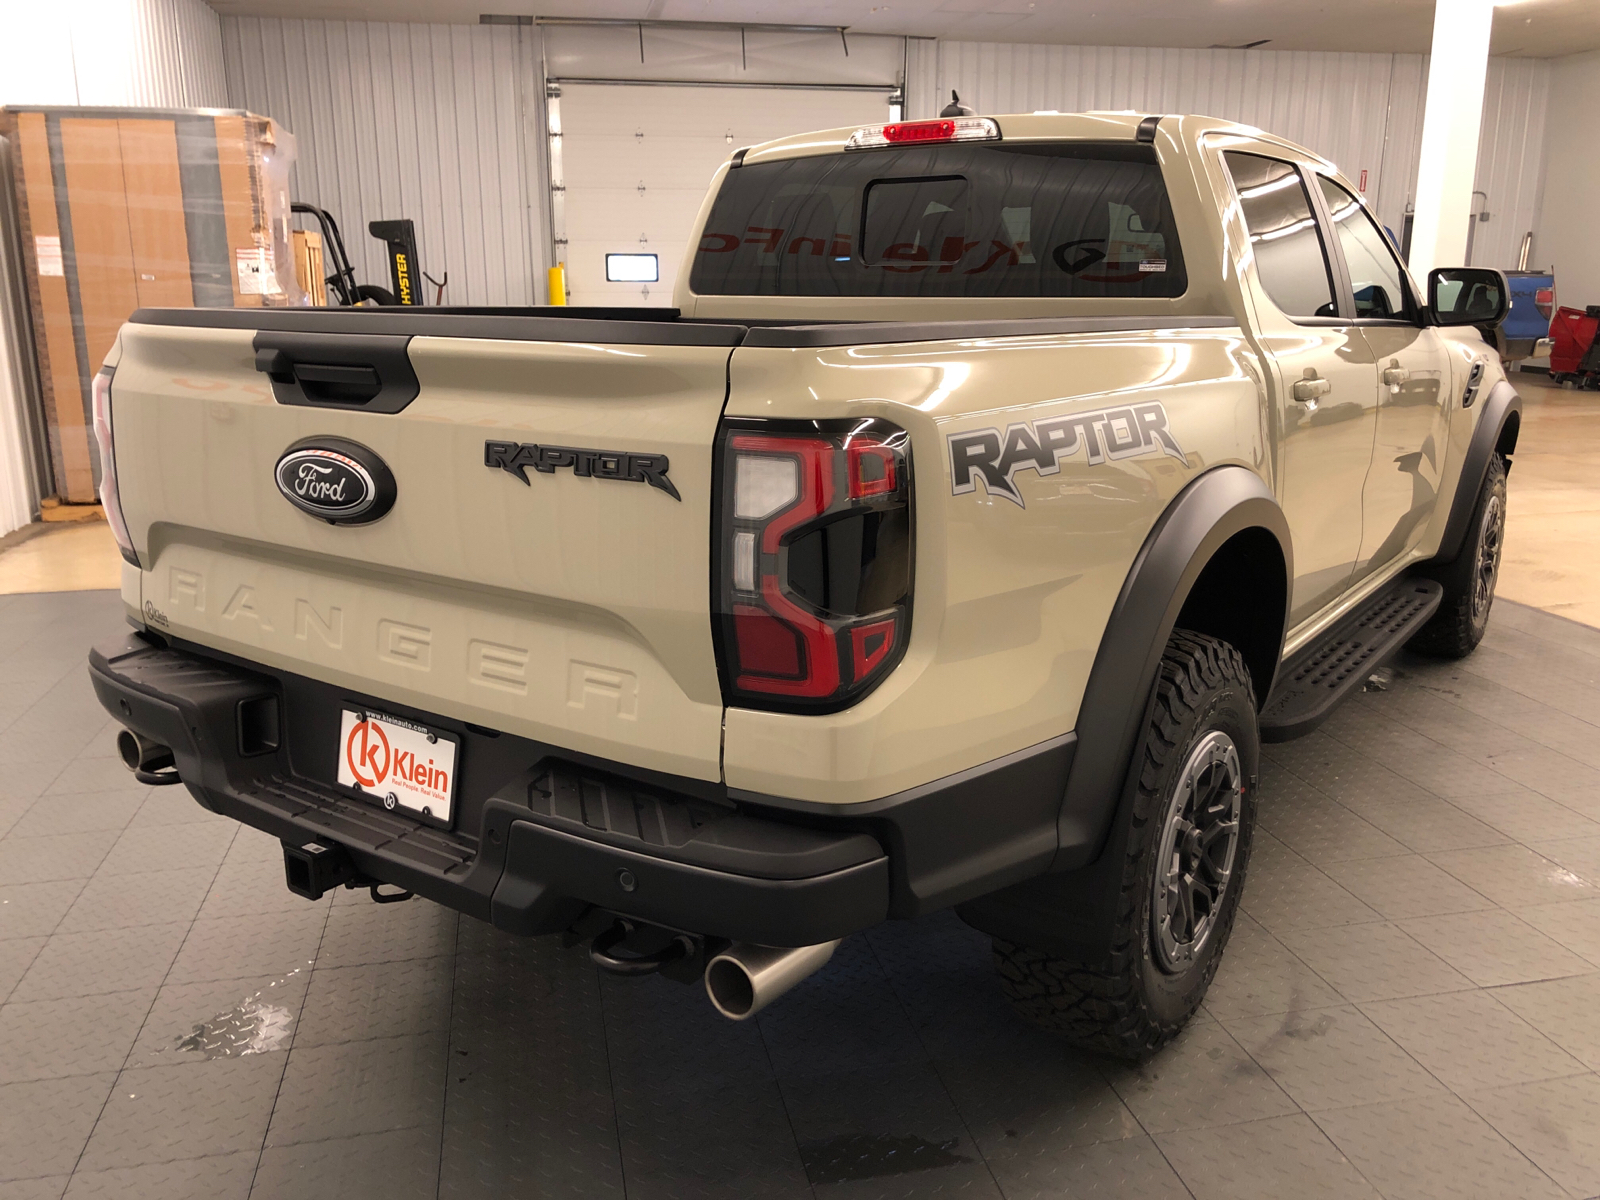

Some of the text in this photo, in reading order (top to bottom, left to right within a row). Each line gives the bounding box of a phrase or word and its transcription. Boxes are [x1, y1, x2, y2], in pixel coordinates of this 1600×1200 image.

[396, 253, 411, 304] HYSTER
[484, 439, 682, 502] RAPTOR
[946, 399, 1190, 510] RAPTOR
[294, 462, 346, 502] Ford
[168, 565, 638, 722] RANGER
[365, 710, 428, 734] www.kleinauto.com
[391, 777, 402, 787] Real
[420, 787, 431, 796] Real
[392, 747, 448, 793] Klein
